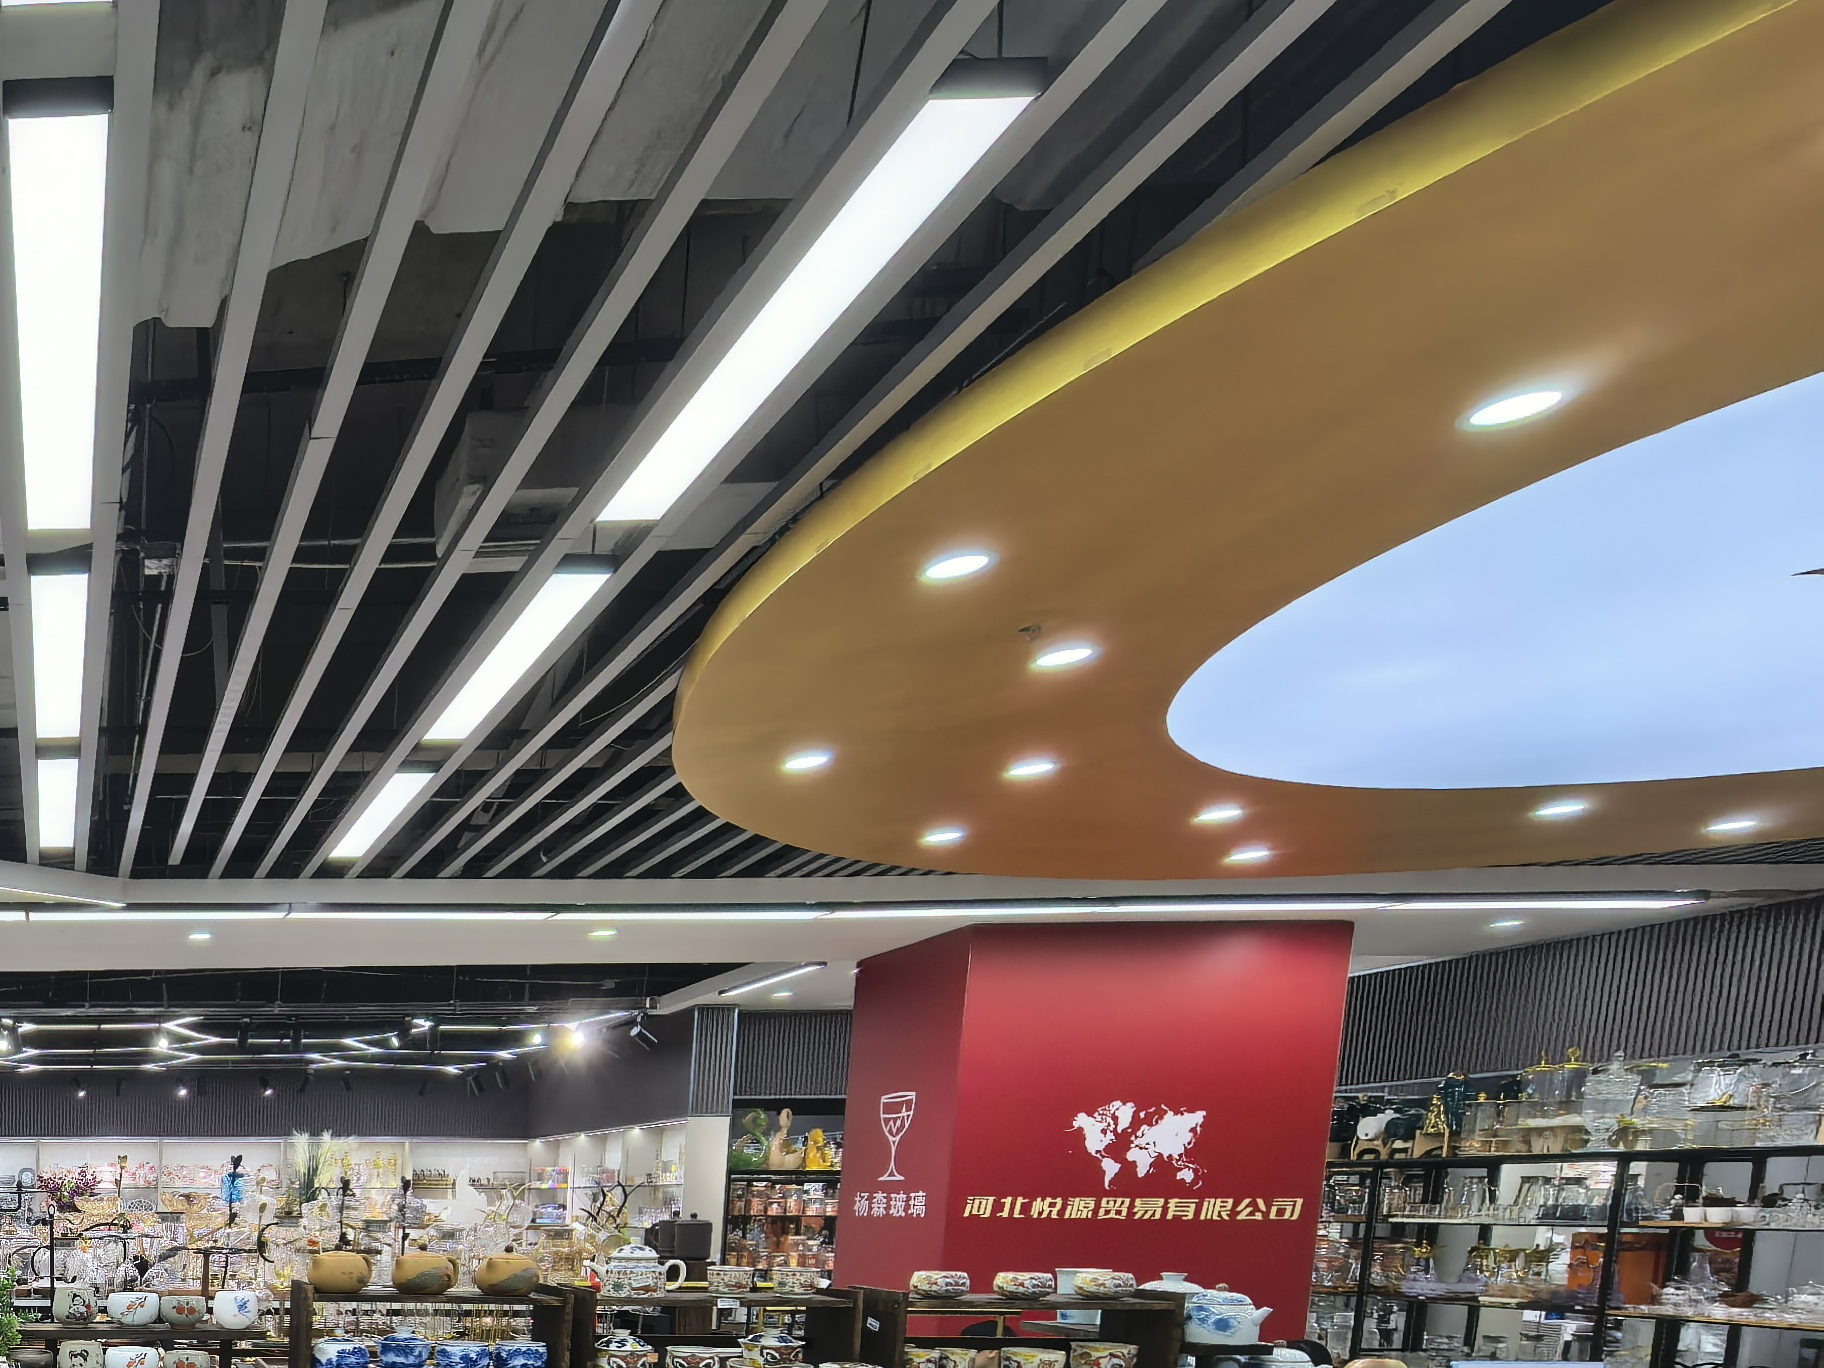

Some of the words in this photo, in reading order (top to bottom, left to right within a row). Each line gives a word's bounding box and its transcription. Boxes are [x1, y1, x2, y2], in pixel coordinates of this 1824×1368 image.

[854, 1191, 926, 1218] 杨森玻璃
[963, 1196, 1304, 1220] 河北悦源贸易有限公司
